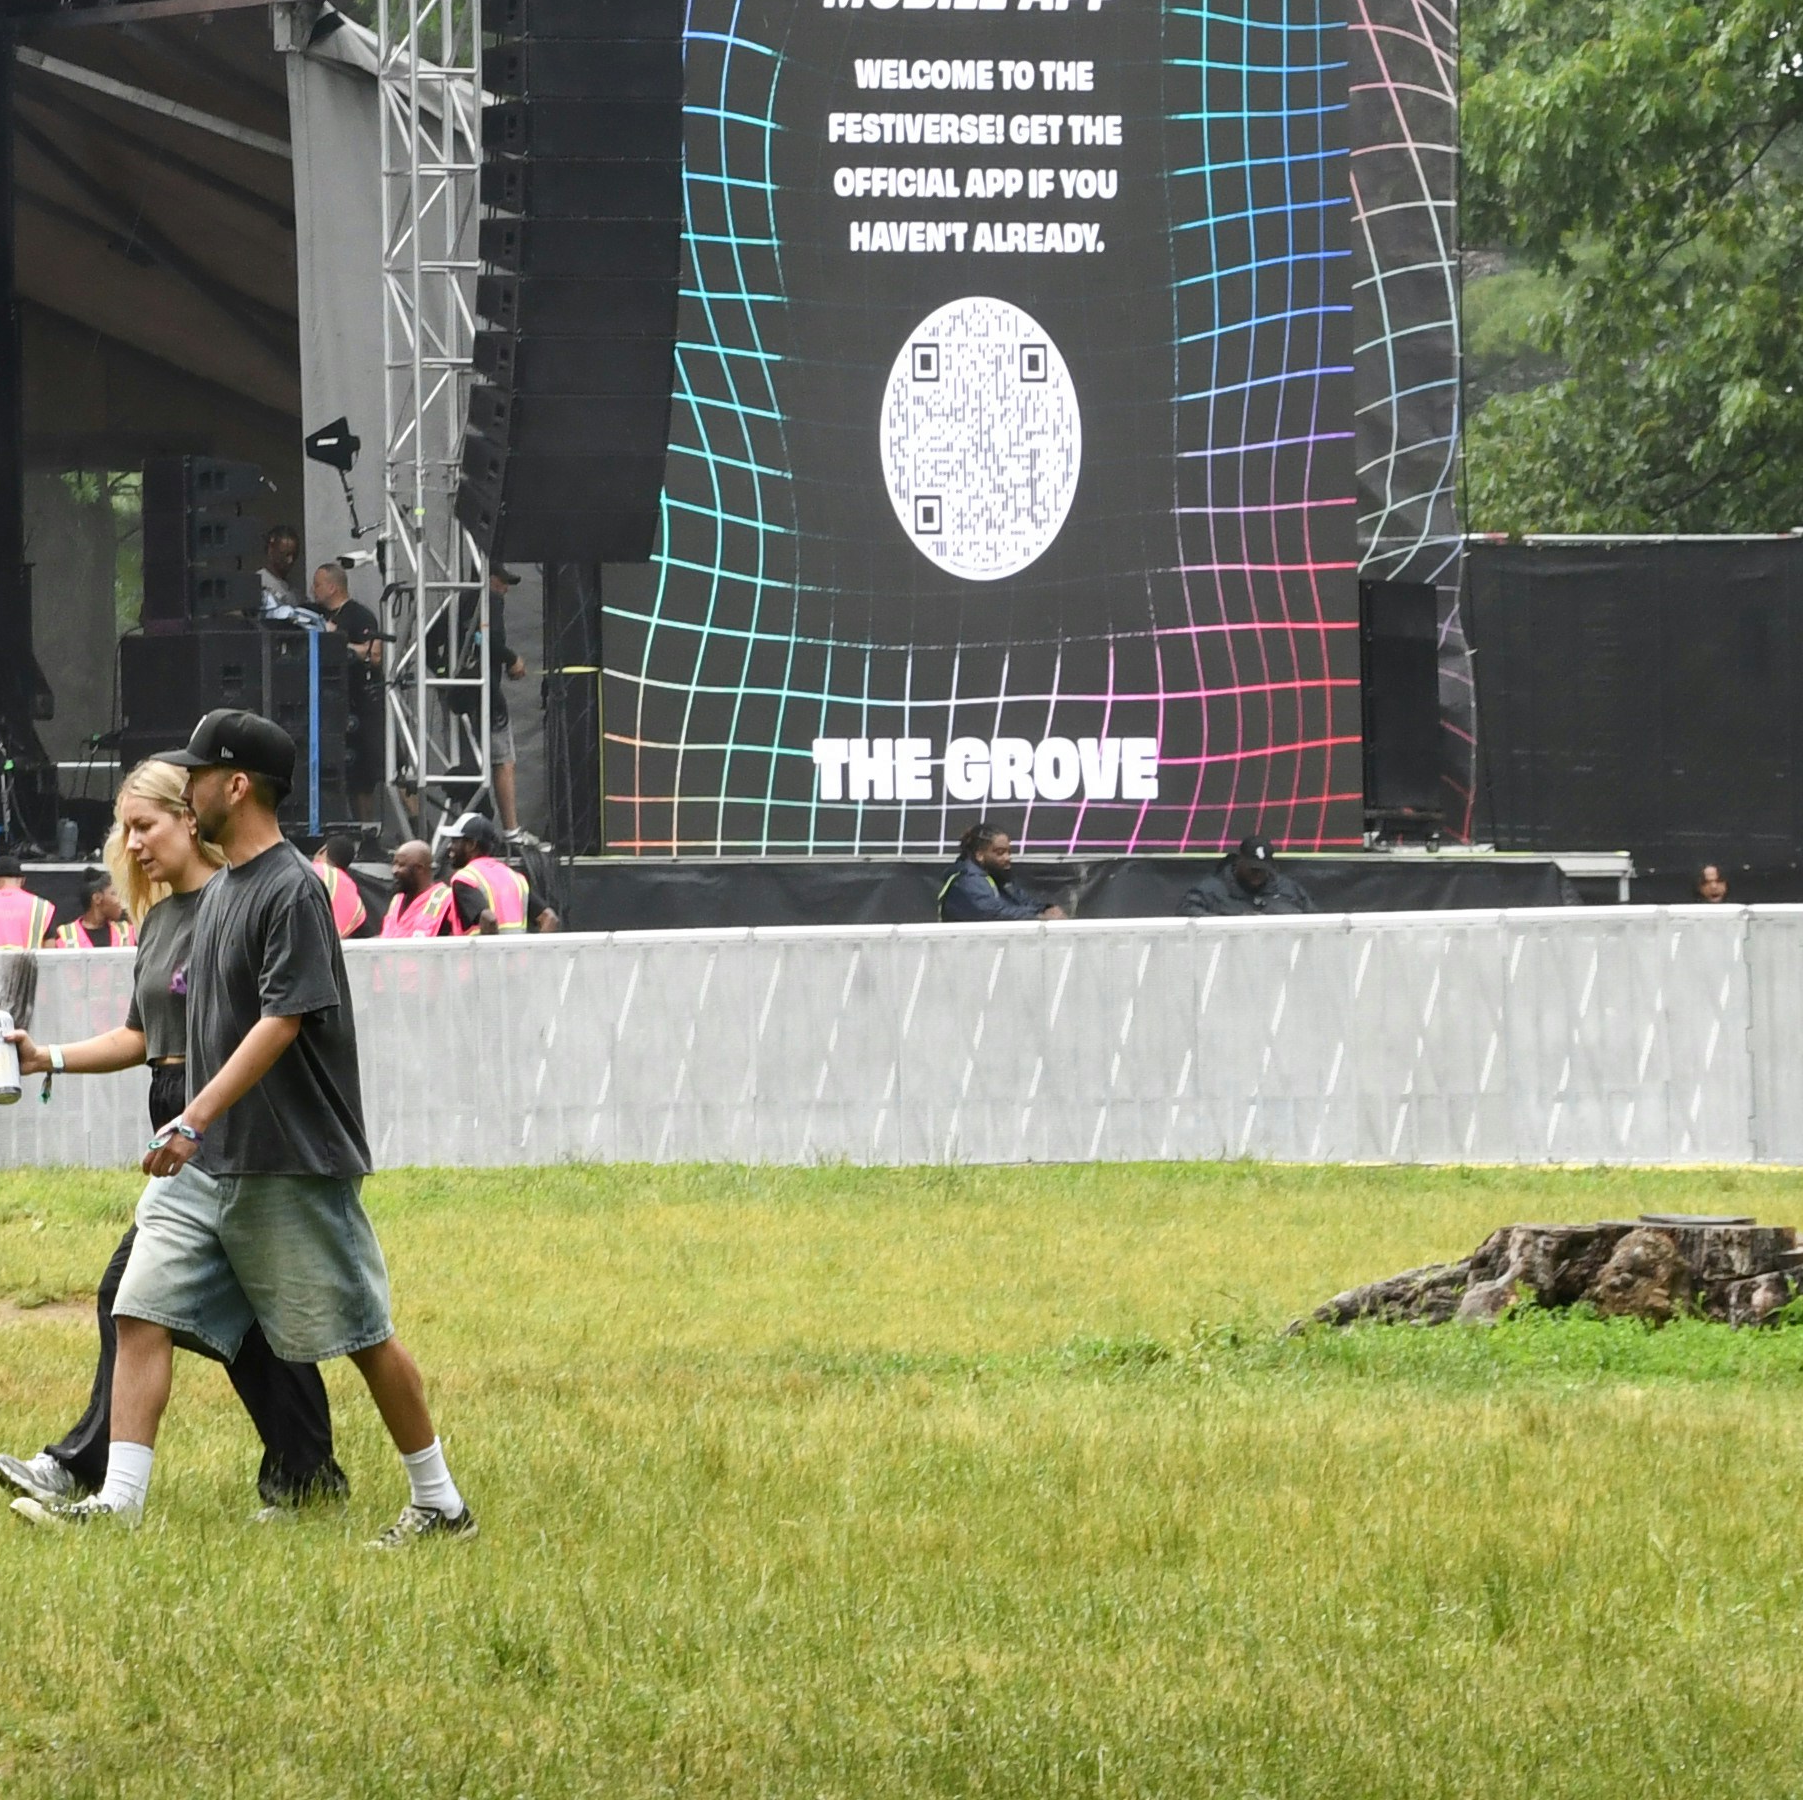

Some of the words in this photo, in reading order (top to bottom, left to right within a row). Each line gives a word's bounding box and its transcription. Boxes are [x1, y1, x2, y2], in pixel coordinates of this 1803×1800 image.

[854, 58, 995, 91] WELCOME
[997, 59, 1036, 92] TO
[1038, 60, 1095, 92] THE
[828, 112, 1006, 145] FESTIVERSE!
[1008, 114, 1064, 146] GET
[1067, 114, 1123, 146] THE
[833, 166, 961, 199] OFFICIAL
[963, 167, 1024, 199] APP
[1027, 168, 1055, 199] IF
[1058, 168, 1118, 200] YOU
[849, 220, 969, 253] HAVEN'T
[971, 221, 1106, 254] ALREADY.
[812, 737, 933, 801] THE
[944, 736, 1159, 801] GROVE
